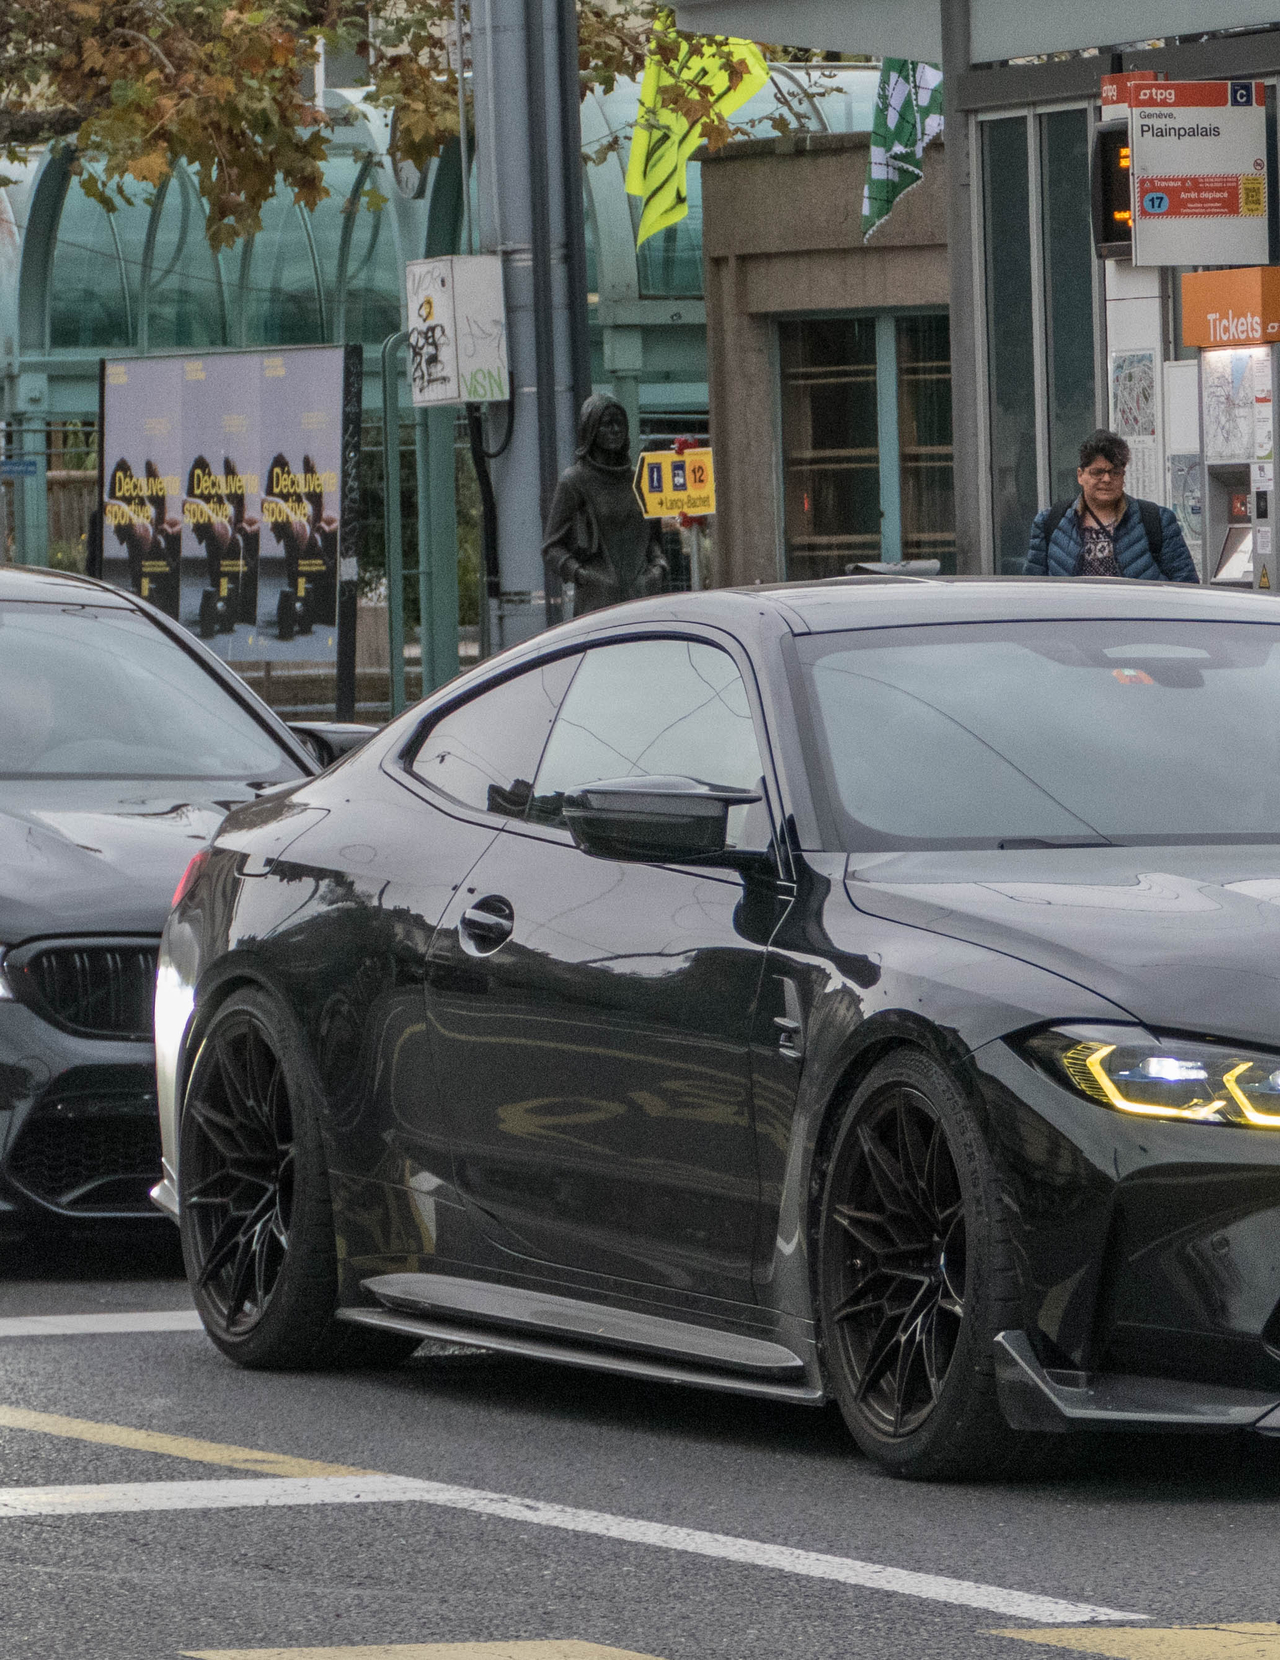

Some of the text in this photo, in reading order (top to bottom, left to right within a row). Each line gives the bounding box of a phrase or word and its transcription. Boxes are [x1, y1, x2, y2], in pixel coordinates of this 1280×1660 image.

[1152, 87, 1175, 103] tpg
[1236, 89, 1247, 102] C
[1139, 110, 1176, 120] Genève,
[1140, 123, 1221, 140] Plainpalais
[1148, 196, 1164, 209] 17
[1200, 191, 1228, 200] déplacé
[1207, 309, 1261, 342] Tickets
[115, 469, 181, 498] Découverte
[194, 467, 259, 495] Découverte
[272, 466, 337, 494] Découverte
[691, 465, 704, 484] 12
[105, 499, 151, 526] sportive
[183, 498, 230, 524] sportive
[262, 497, 308, 523] sportive
